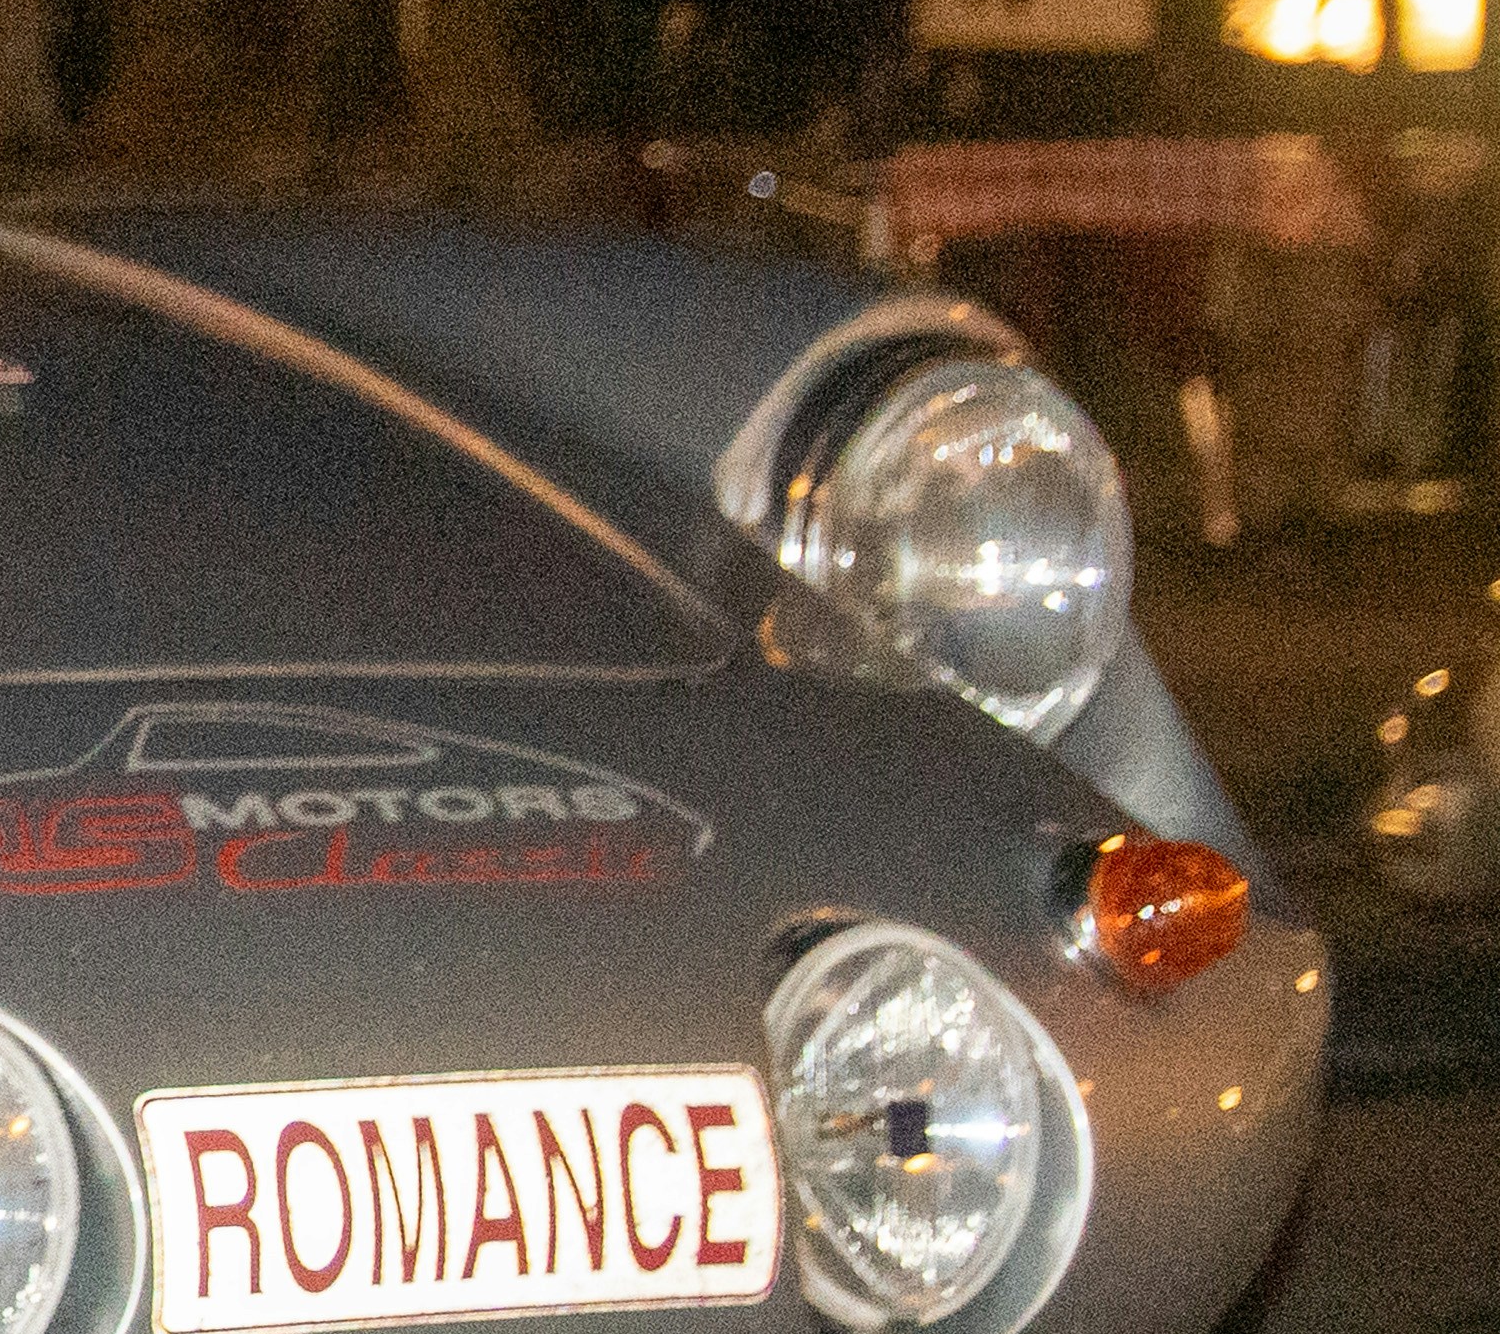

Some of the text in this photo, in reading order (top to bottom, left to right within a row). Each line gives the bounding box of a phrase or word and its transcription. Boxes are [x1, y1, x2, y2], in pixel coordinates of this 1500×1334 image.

[180, 786, 637, 830] MOTORS
[218, 827, 660, 891] Classic
[184, 1101, 747, 1298] ROMANCE
